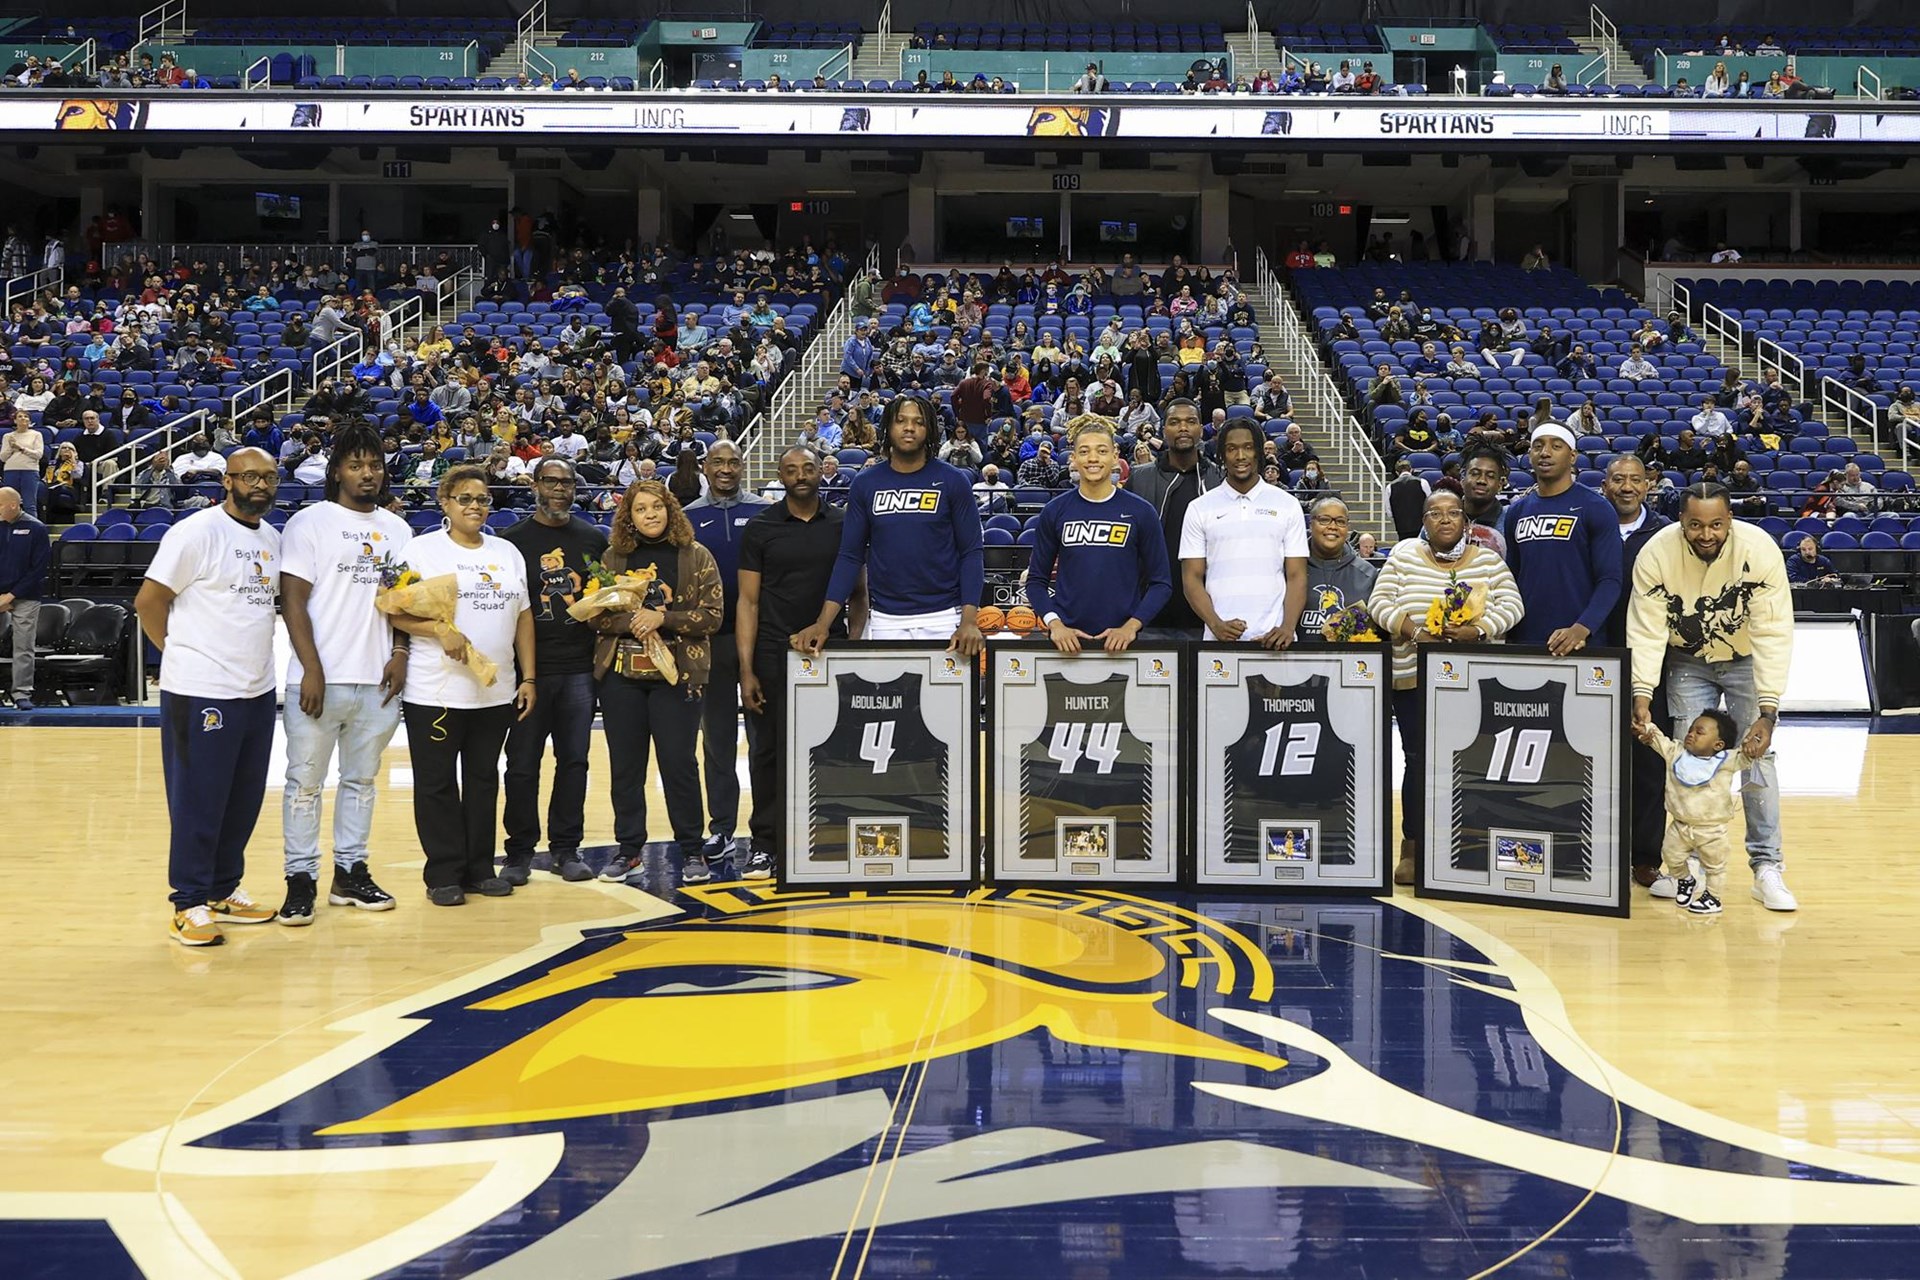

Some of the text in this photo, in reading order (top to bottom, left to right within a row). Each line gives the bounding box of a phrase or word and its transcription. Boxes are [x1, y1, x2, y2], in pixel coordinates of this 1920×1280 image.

[439, 52, 454, 60] 213
[590, 52, 605, 61] 212
[773, 54, 788, 63] 212
[907, 54, 922, 63] 211
[1528, 60, 1543, 68] 210
[1676, 61, 1691, 69] 209
[410, 106, 525, 127] SPARTANS
[635, 108, 684, 128] UNCG
[1381, 113, 1494, 133] SPARTANS
[1602, 115, 1652, 135] UNCG
[385, 163, 409, 177] 111
[1054, 175, 1079, 189] 109
[809, 201, 830, 214] 110
[1312, 203, 1334, 217] 108
[872, 489, 941, 516] UNCG
[1062, 520, 1131, 548] UNCG
[1515, 514, 1578, 544] UNCG
[342, 531, 359, 542] Big
[337, 563, 370, 573] Senior
[352, 574, 379, 585] Squa
[492, 589, 520, 601] Night
[473, 600, 505, 611] Squad
[851, 695, 902, 709] ABDULSALAM
[1065, 696, 1109, 710] HUNTER
[1263, 698, 1315, 713] THOMPSON
[1493, 701, 1550, 717] BUCKINGHAM
[859, 720, 896, 775] 4
[1047, 721, 1123, 775] 44
[1258, 721, 1322, 776] 12
[1485, 726, 1553, 784] 10
